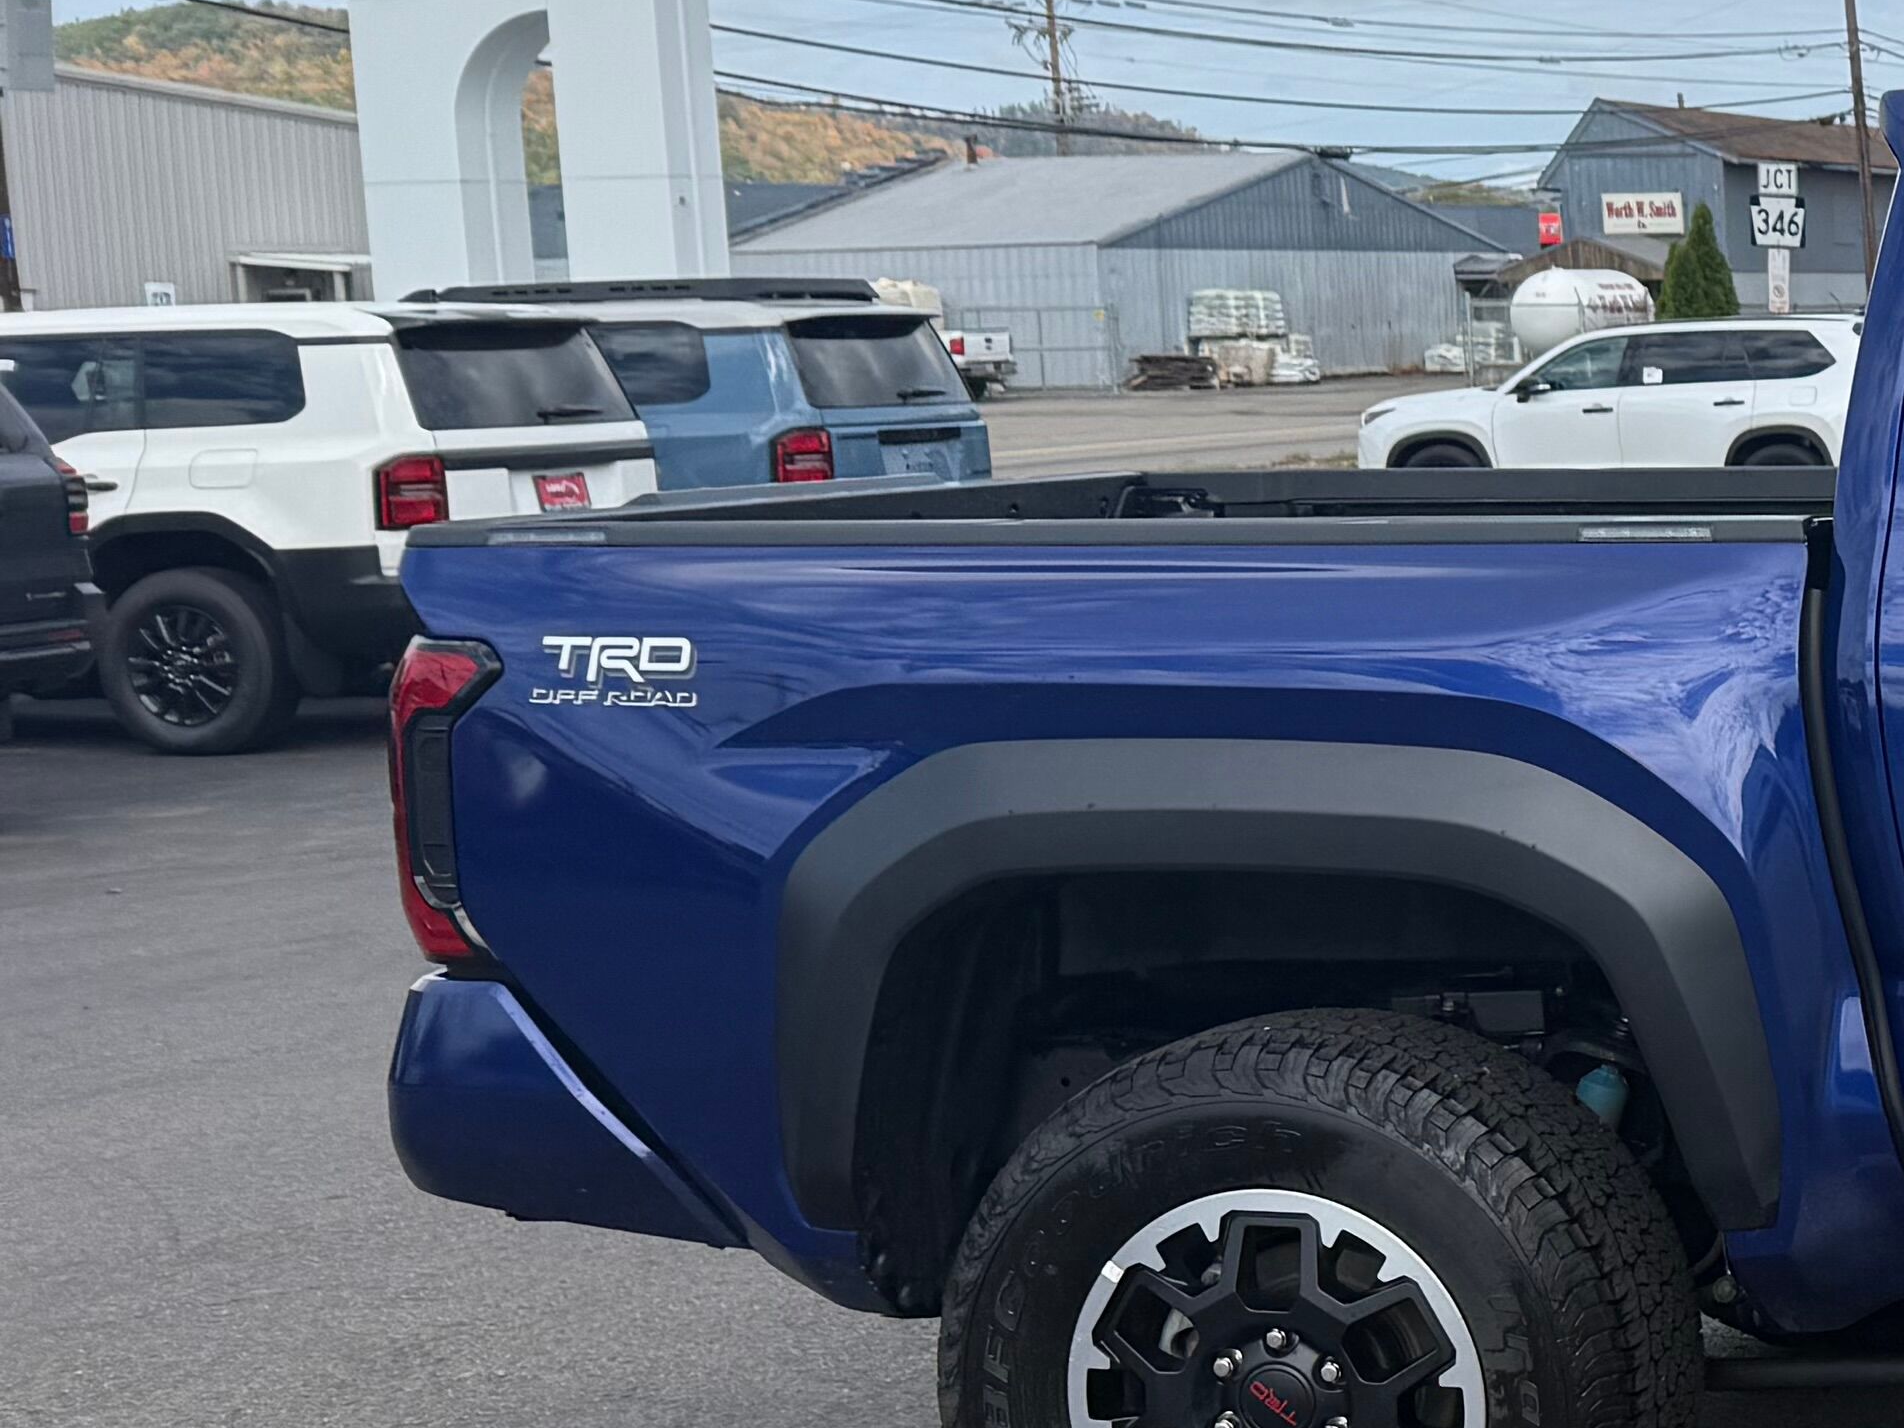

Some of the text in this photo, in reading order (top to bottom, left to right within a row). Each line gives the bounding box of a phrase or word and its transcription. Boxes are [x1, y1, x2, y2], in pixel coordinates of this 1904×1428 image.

[1761, 168, 1793, 190] JCT
[1648, 200, 1677, 218] Smith
[1757, 208, 1800, 237] 346
[542, 635, 694, 683] TRD
[529, 687, 698, 707] OFF ROAD
[1249, 1381, 1297, 1426] TRD
